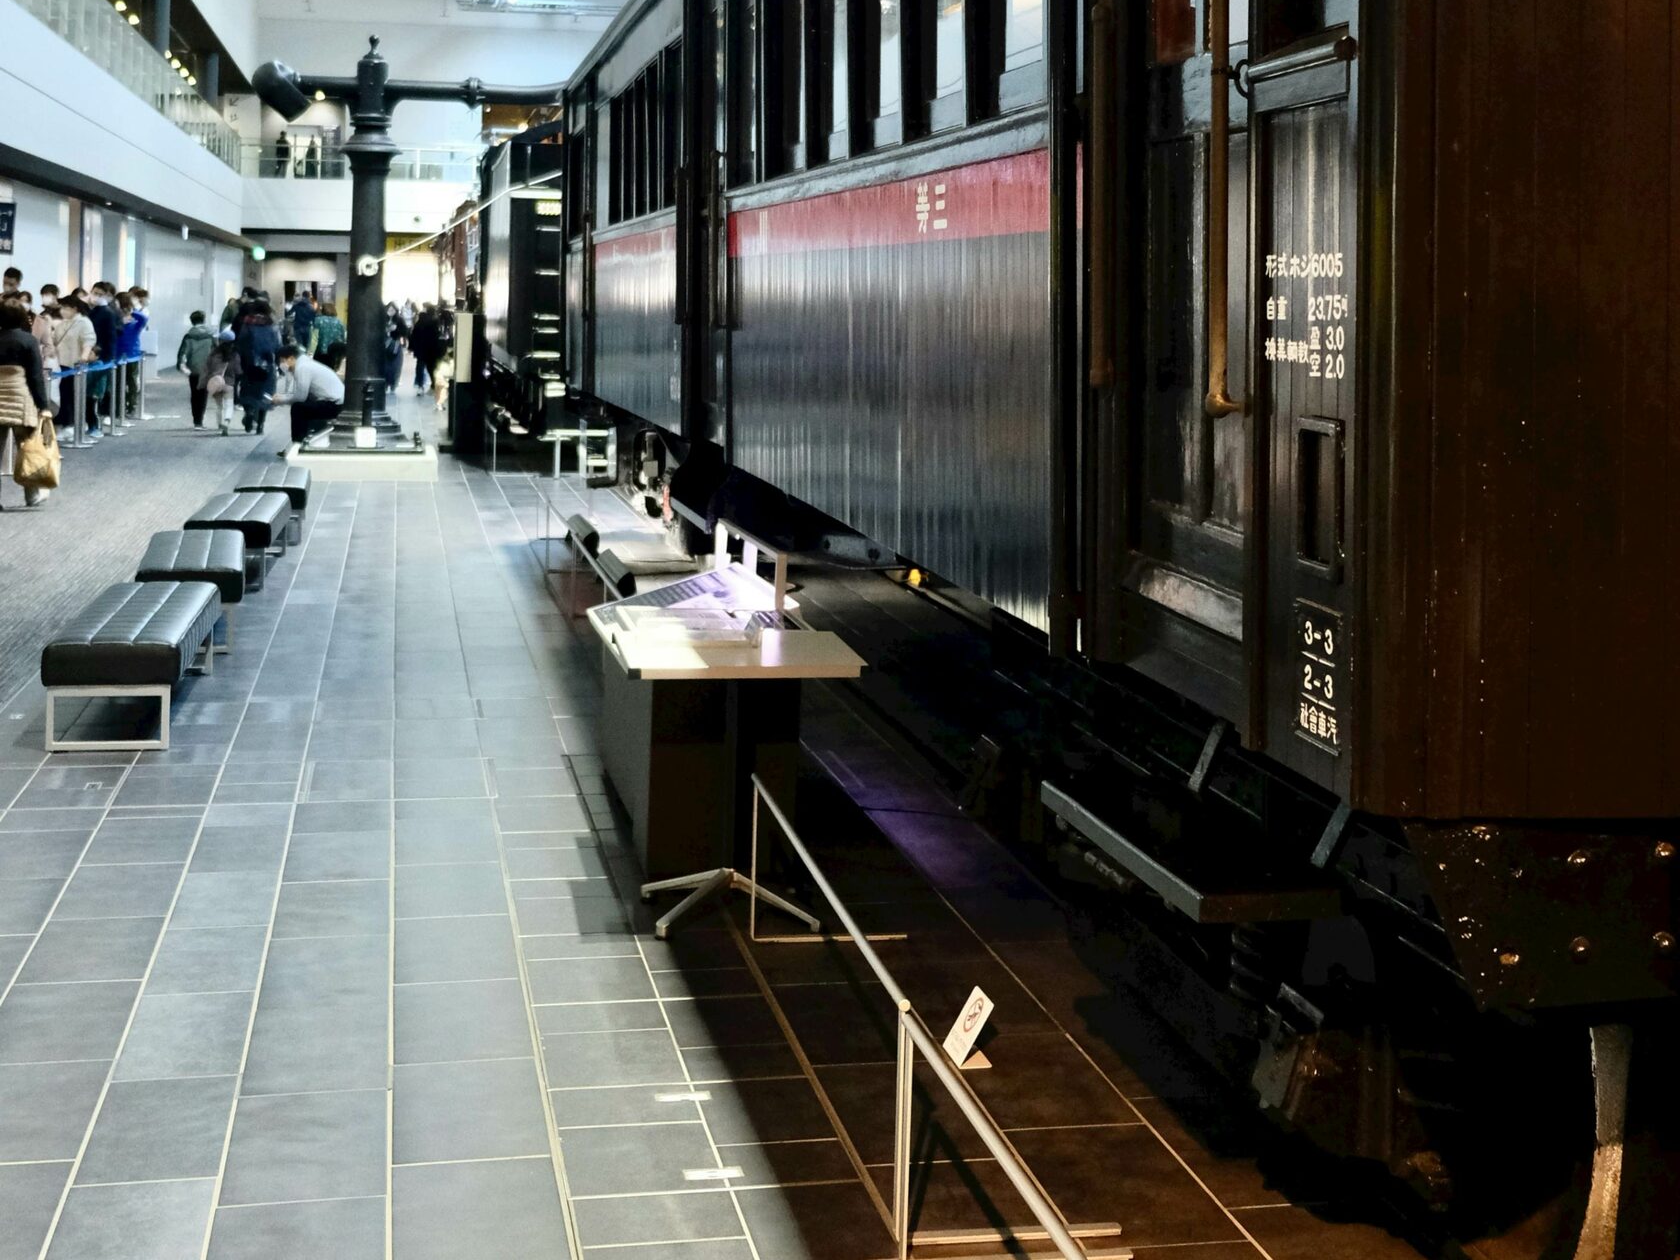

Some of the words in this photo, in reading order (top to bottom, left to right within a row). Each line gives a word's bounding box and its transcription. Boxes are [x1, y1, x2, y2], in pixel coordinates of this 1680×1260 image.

[1266, 295, 1288, 320] 自重
[1325, 325, 1345, 351] 3.0
[1325, 353, 1345, 379] 2.0
[1304, 620, 1334, 655] 3-3
[1303, 663, 1333, 700] 2-3
